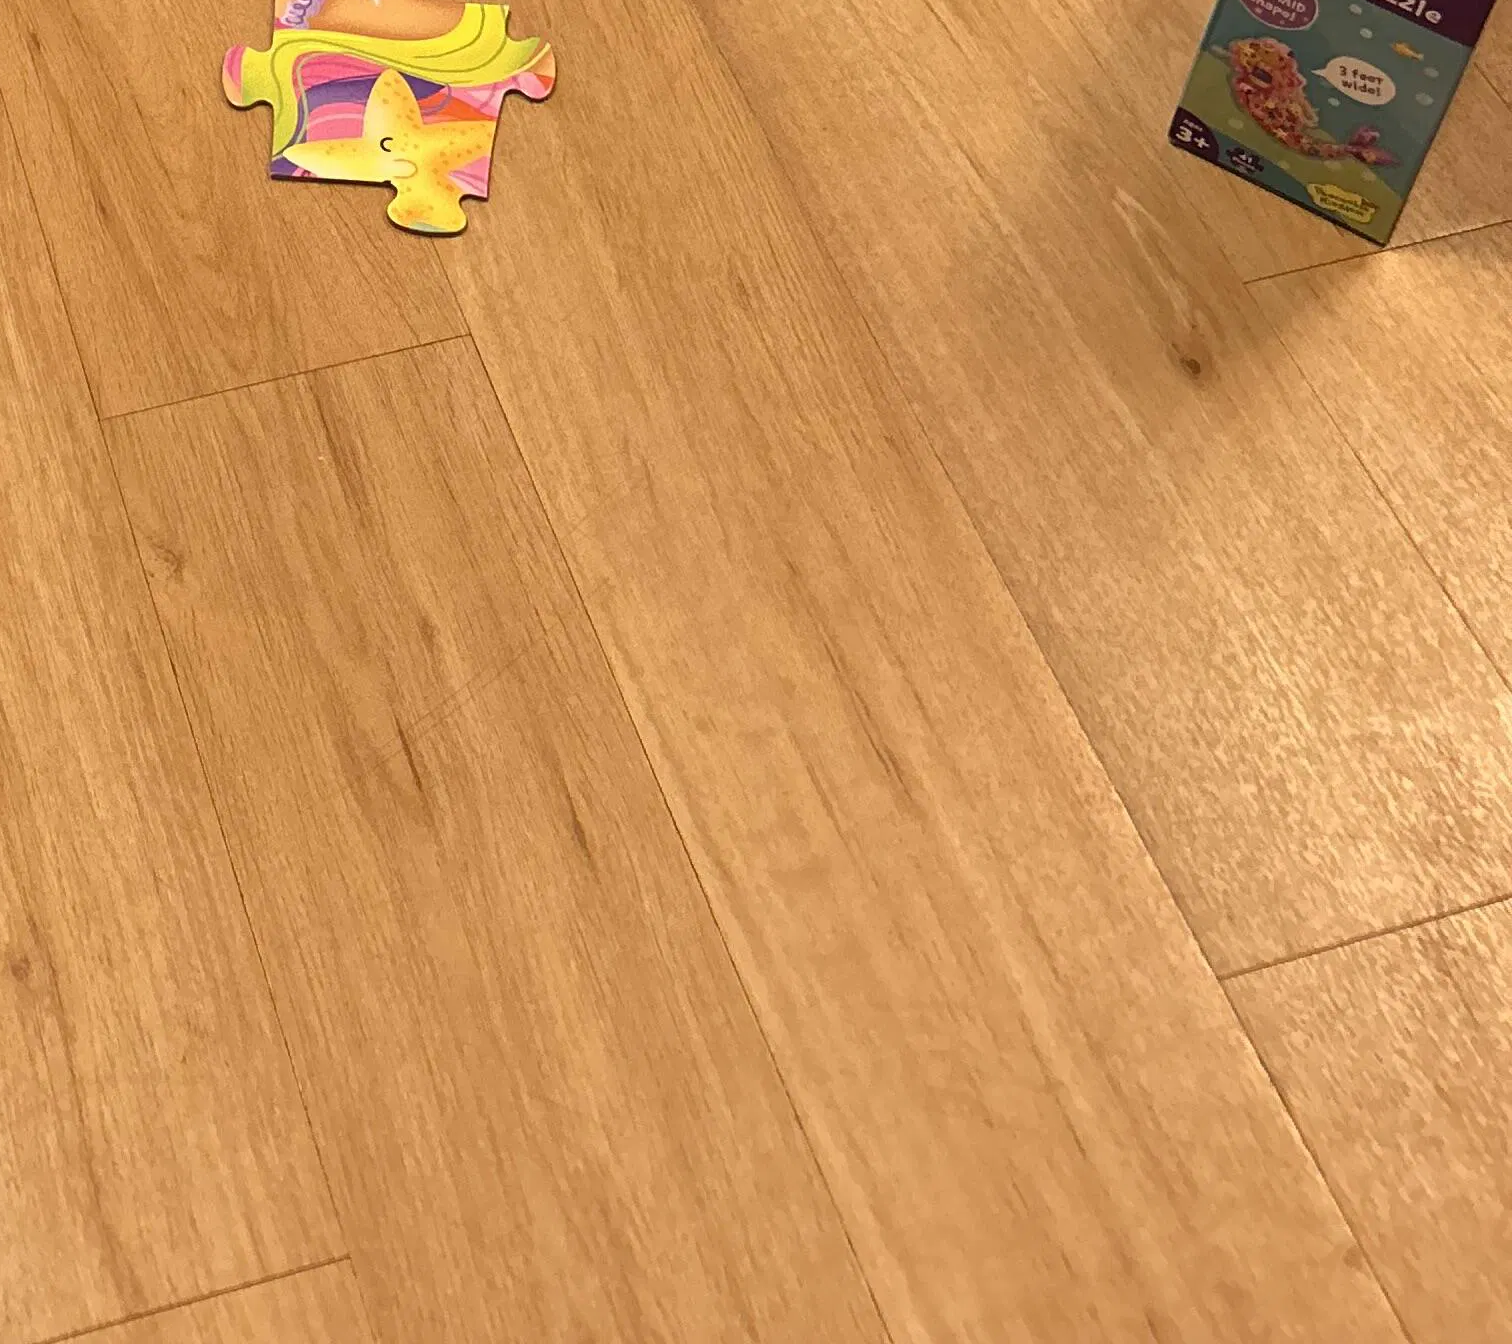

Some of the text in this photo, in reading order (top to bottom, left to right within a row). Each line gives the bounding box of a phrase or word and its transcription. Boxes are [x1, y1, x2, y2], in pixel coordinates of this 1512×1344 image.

[1339, 65, 1348, 77] 3
[1341, 80, 1381, 97] wide!
[1175, 124, 1210, 149] 3+
